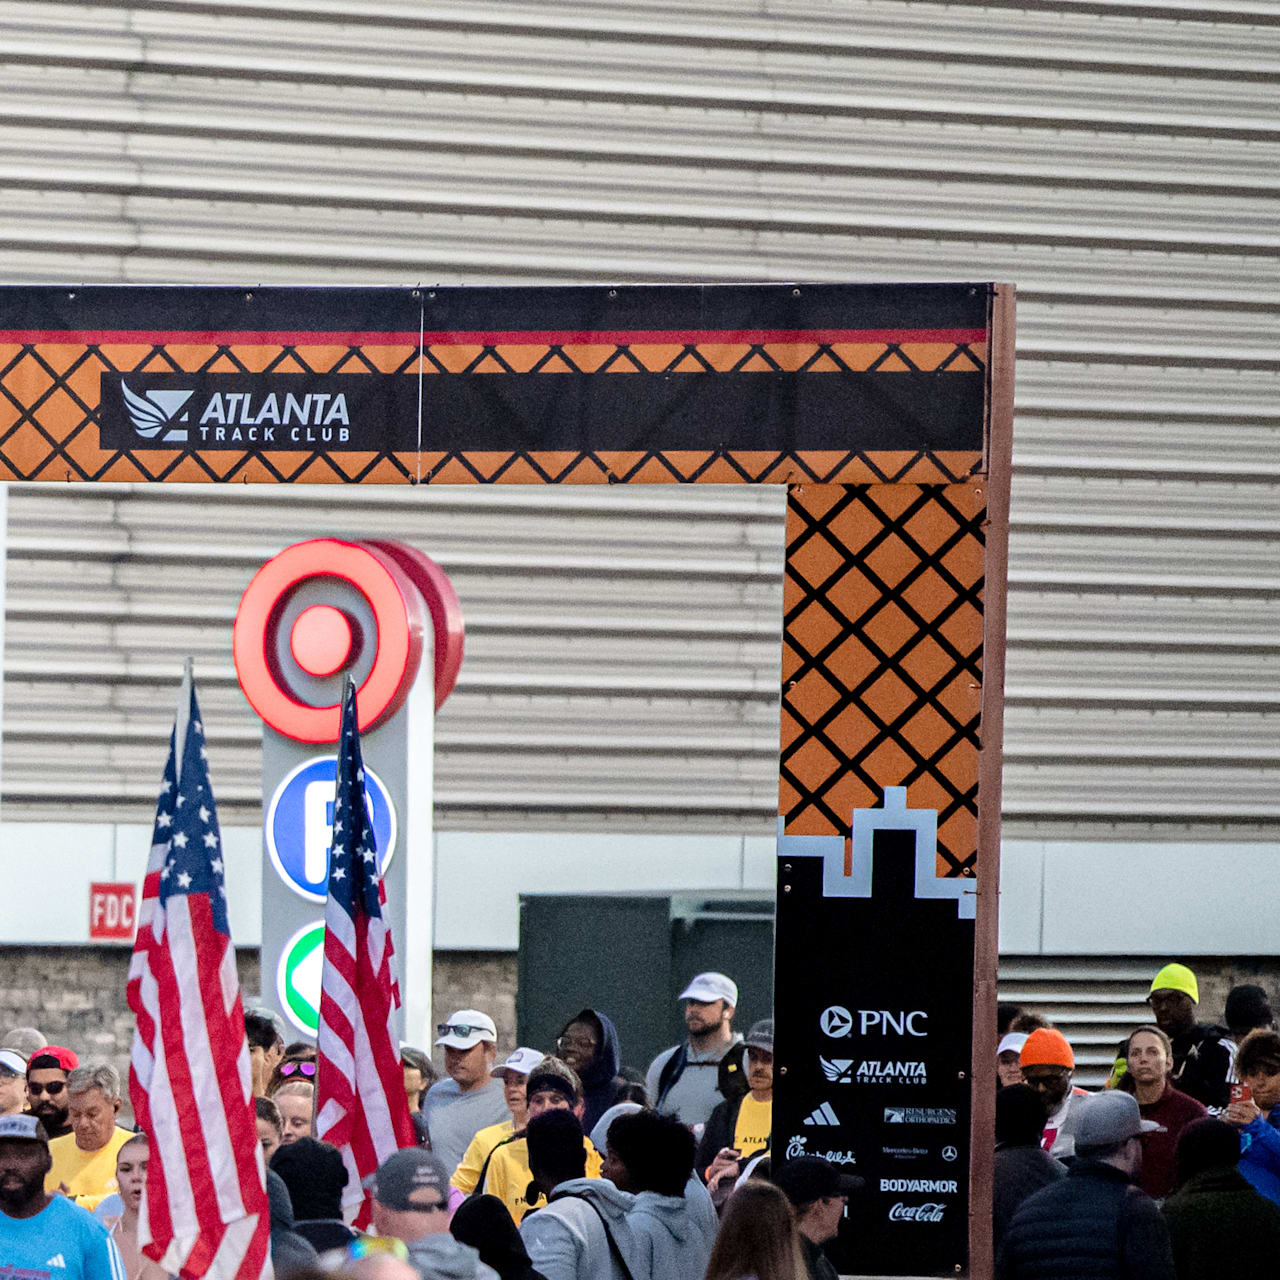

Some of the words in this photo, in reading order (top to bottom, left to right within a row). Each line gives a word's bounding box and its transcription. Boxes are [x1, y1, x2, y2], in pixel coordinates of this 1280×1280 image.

[199, 392, 350, 426] ATLANTA
[200, 427, 276, 442] TRACK
[291, 427, 351, 442] CLUB
[93, 892, 133, 928] FDC
[858, 1009, 928, 1037] PNC
[856, 1061, 927, 1077] ATLANTA
[899, 1077, 927, 1085] CLUB
[879, 1178, 958, 1193] BODYARMOR
[889, 1202, 947, 1222] Coca-Cola
